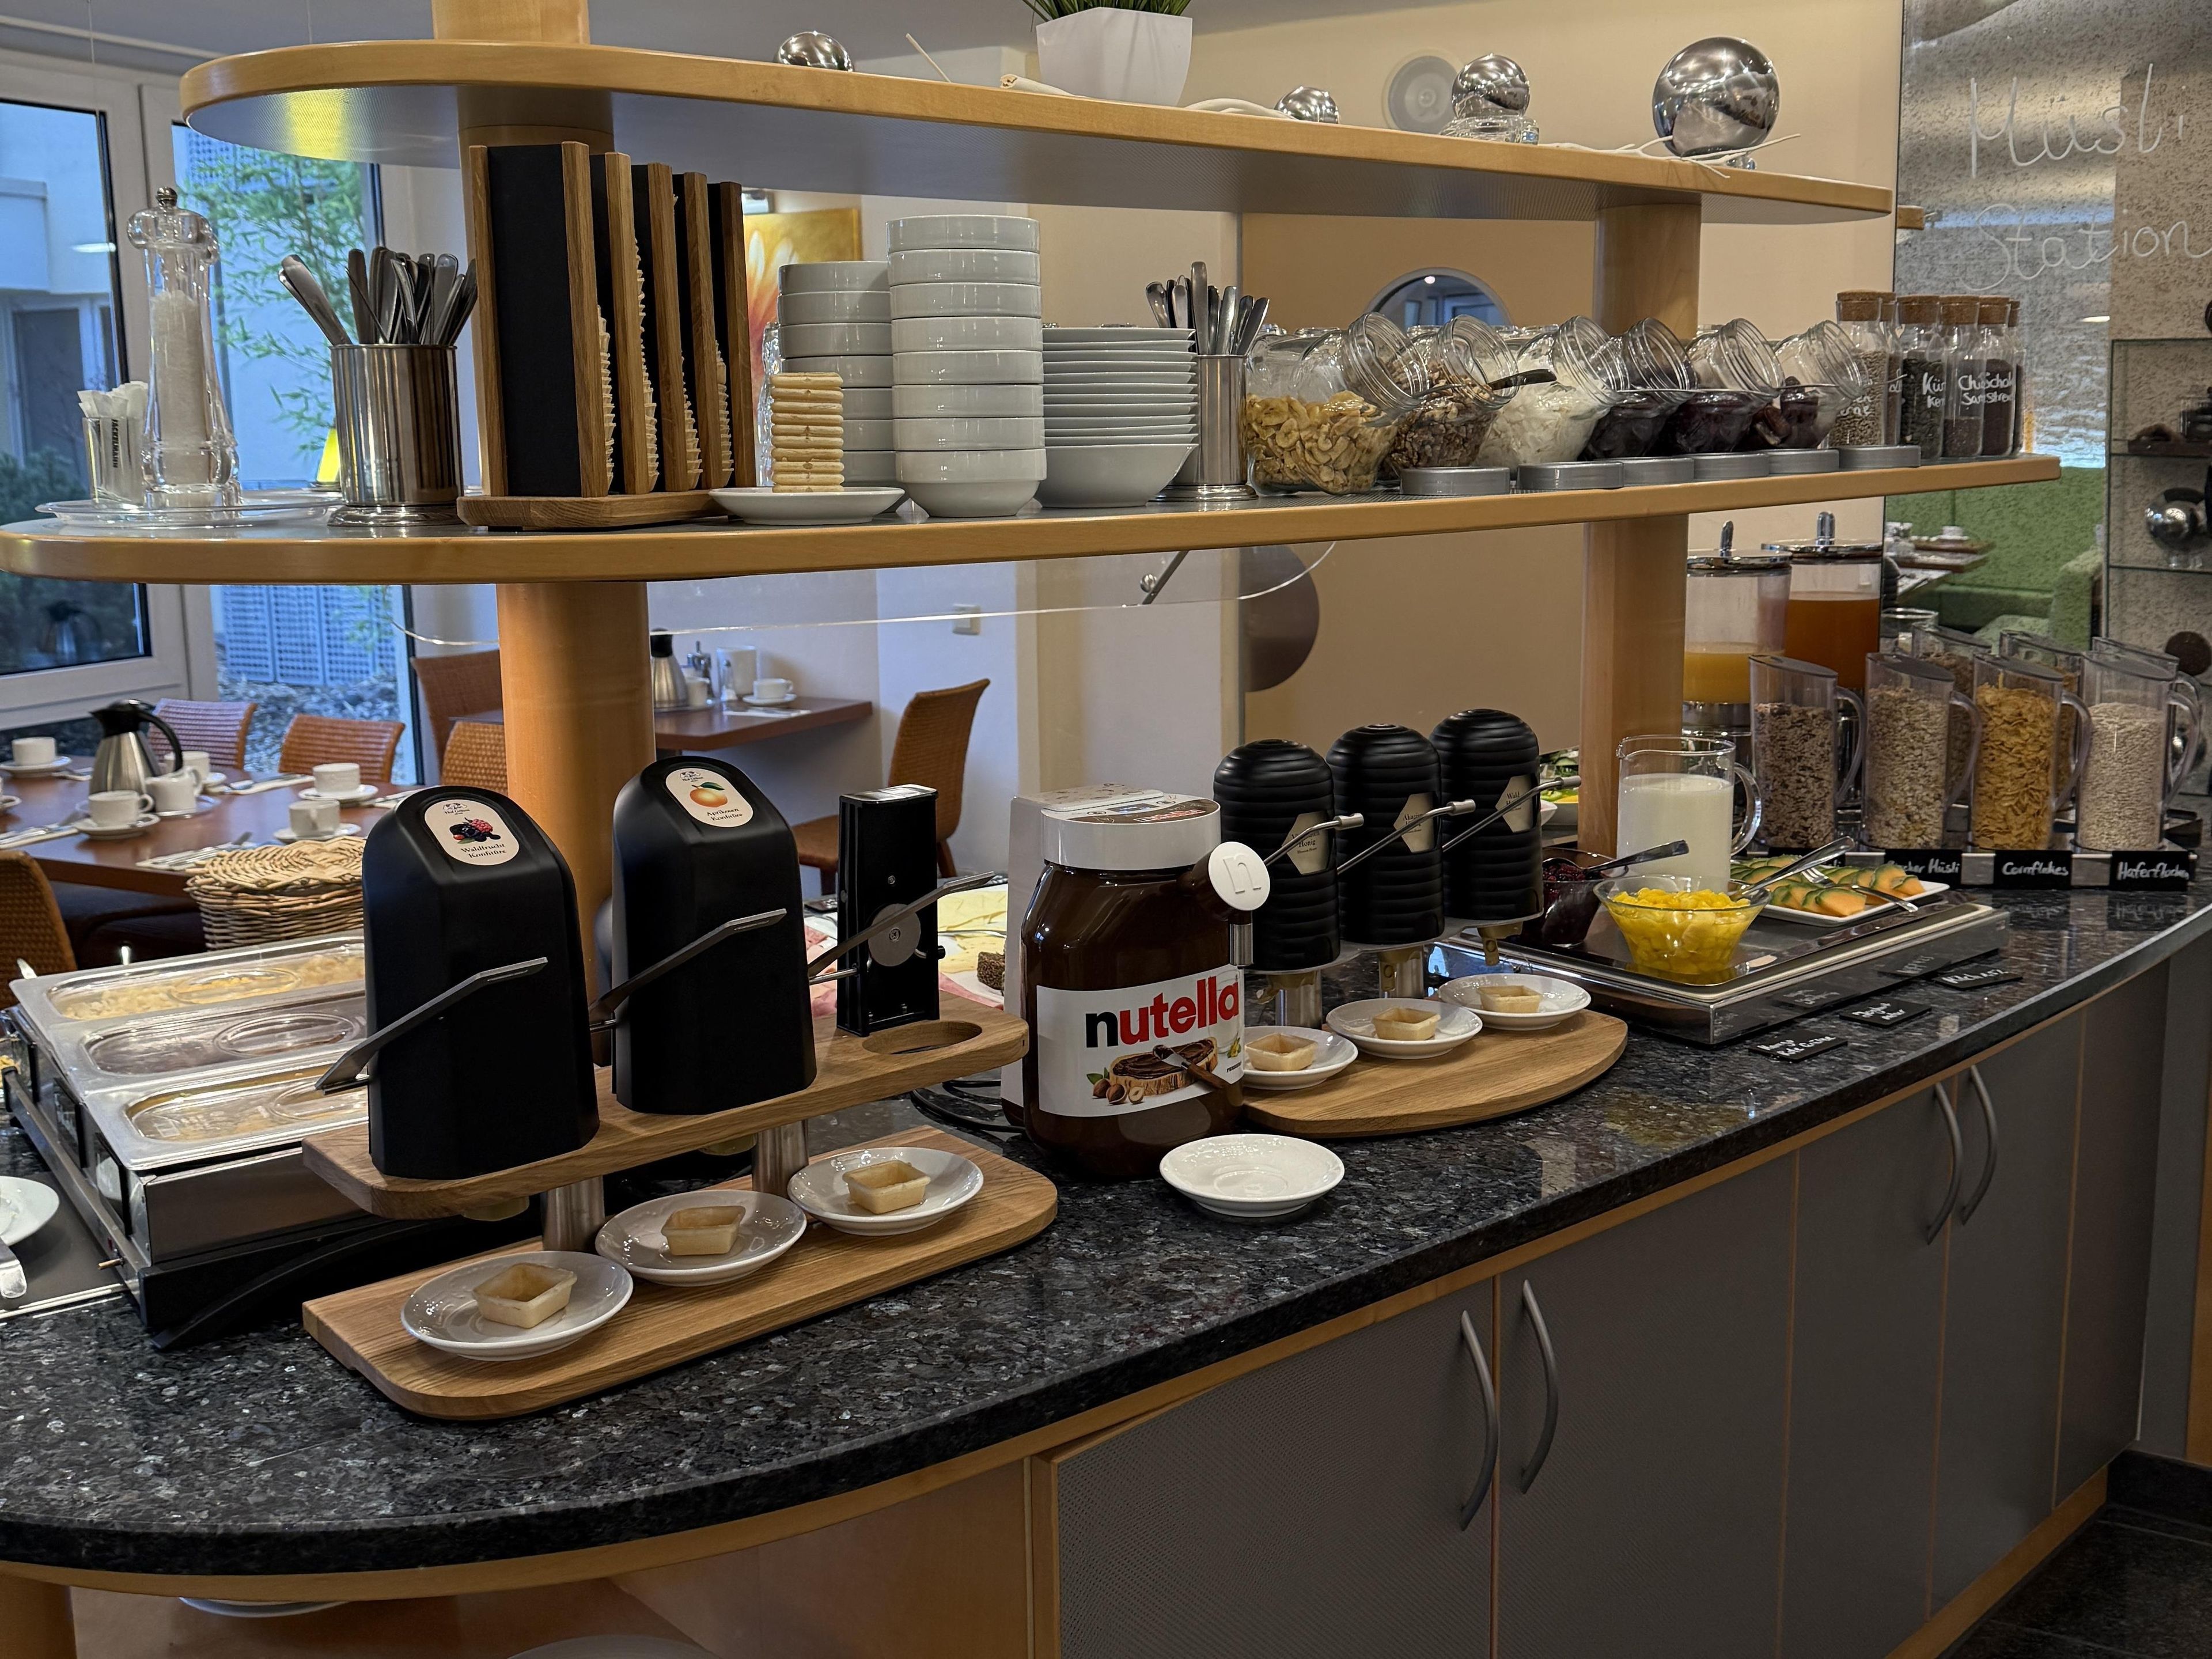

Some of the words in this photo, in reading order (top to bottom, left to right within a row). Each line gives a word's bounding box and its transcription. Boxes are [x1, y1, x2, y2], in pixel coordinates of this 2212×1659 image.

[1959, 203, 2212, 291] Station
[1922, 372, 1946, 395] Kür
[2001, 861, 2069, 876] Cornflakes
[1085, 975, 1239, 1048] nutella
